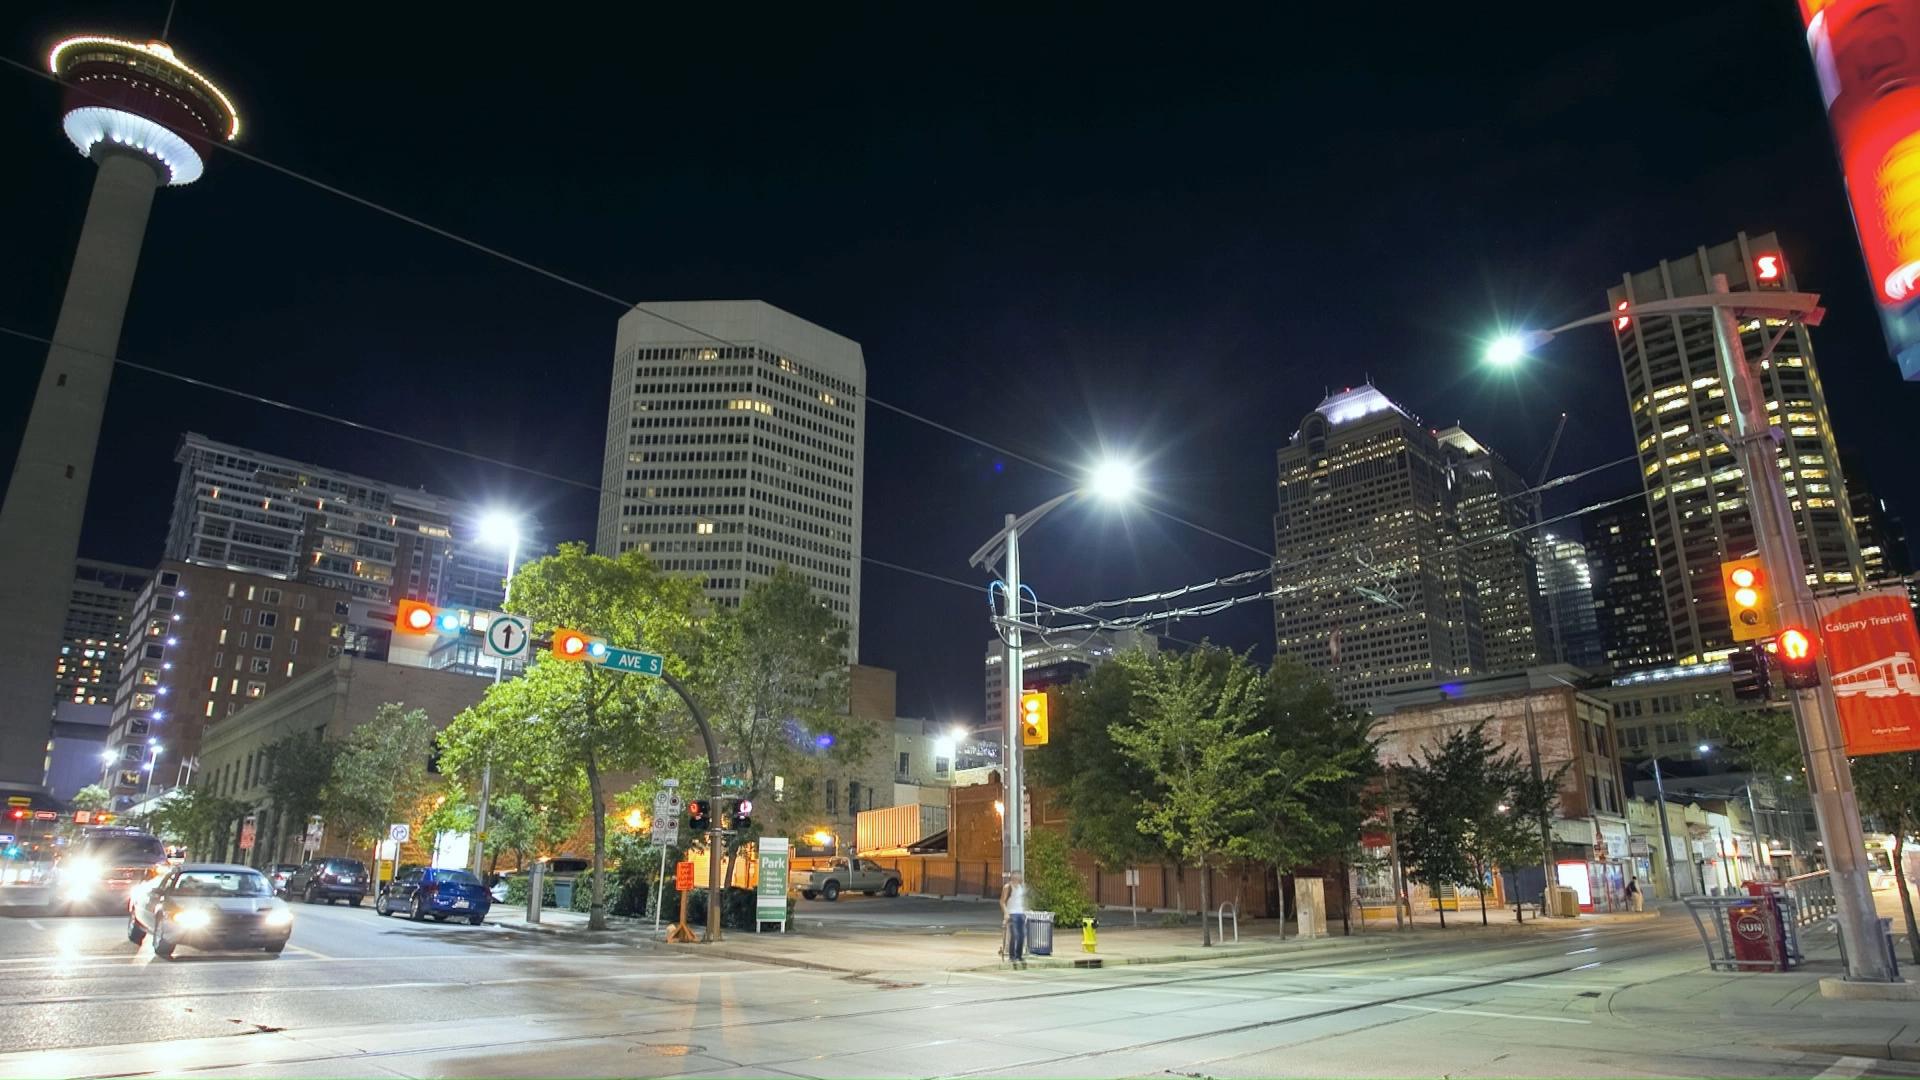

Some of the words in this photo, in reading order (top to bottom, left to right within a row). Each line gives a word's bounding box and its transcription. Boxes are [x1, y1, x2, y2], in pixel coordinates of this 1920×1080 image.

[1825, 619, 1867, 633] Calgary
[1869, 612, 1908, 626] Transit
[618, 653, 642, 669] AVE
[649, 658, 658, 672] S
[761, 856, 785, 869] Park
[1739, 922, 1762, 932] SUN
